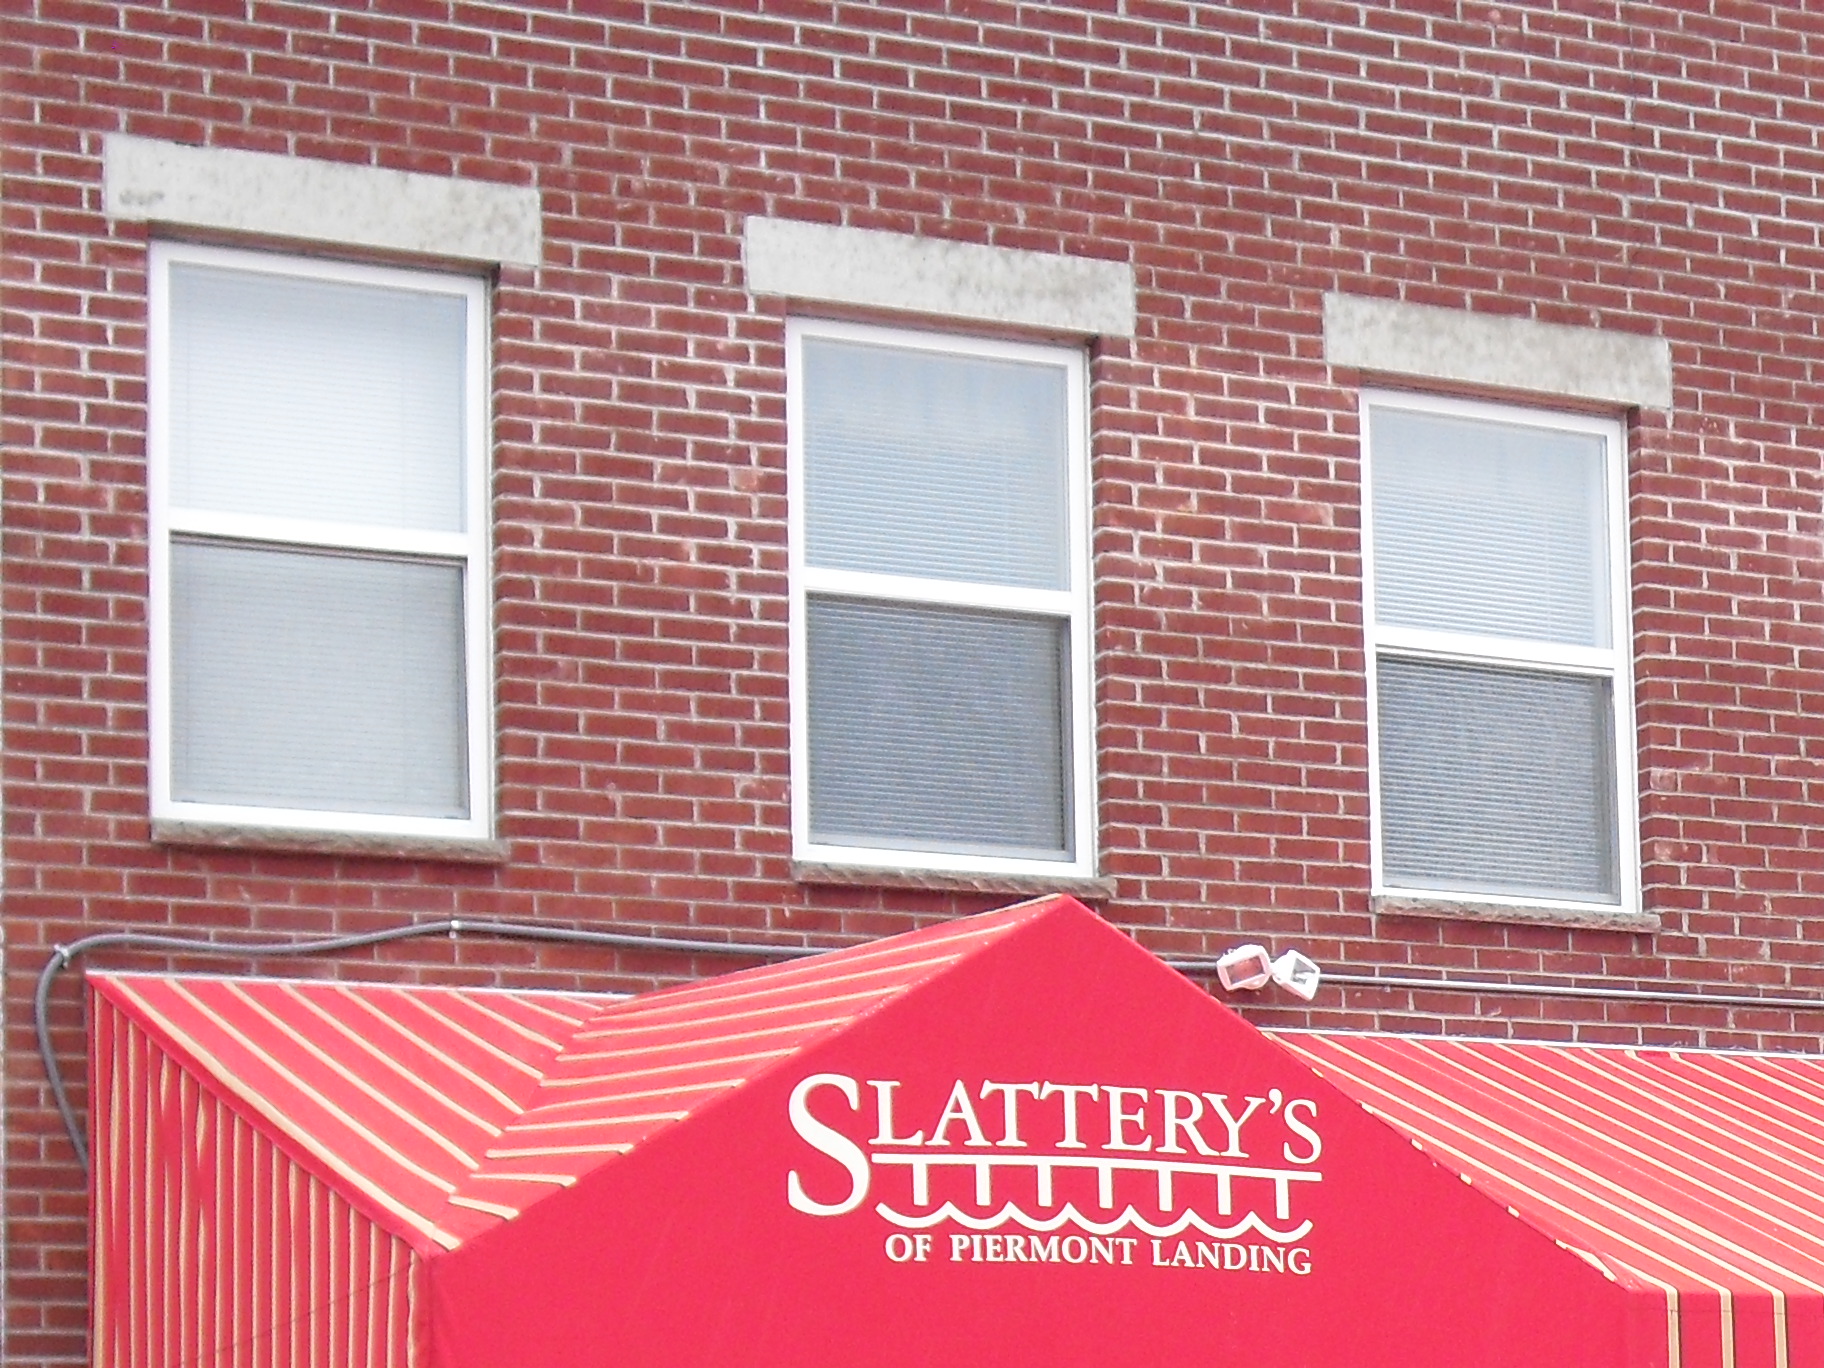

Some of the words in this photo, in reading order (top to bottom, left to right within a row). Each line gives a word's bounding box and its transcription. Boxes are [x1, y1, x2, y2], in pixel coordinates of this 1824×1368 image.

[787, 1073, 1323, 1216] SLATTERY'S
[885, 1233, 932, 1263] OF
[949, 1234, 1138, 1266] PIERMONT
[1150, 1239, 1313, 1275] LANDING
